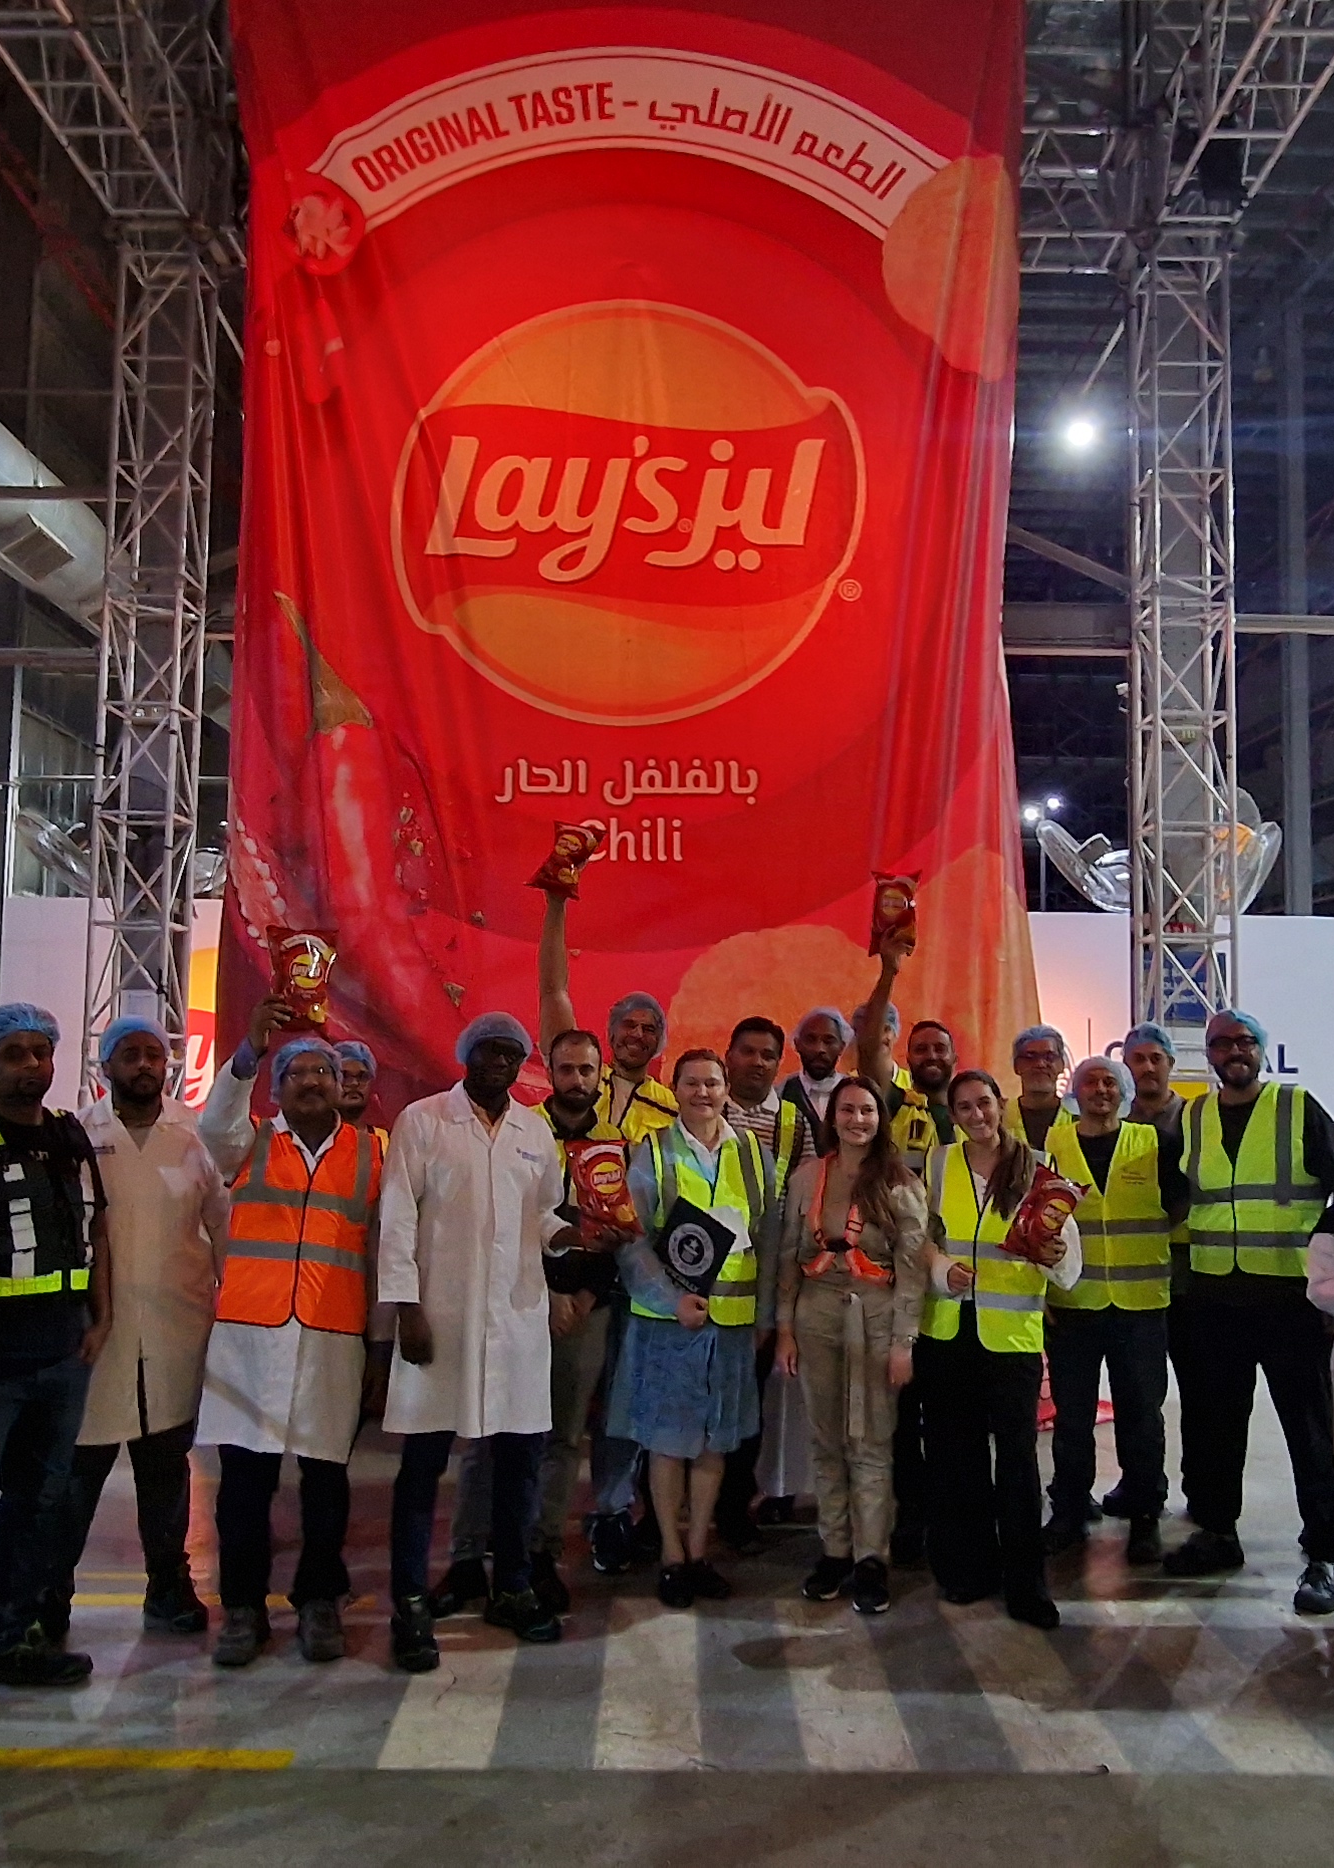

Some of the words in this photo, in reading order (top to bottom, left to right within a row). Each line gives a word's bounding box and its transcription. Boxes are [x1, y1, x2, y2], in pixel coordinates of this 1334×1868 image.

[351, 102, 510, 192] ORIGINAL
[508, 82, 616, 132] TASTE
[792, 130, 907, 200] الطعم
[424, 435, 689, 581] Lay's
[643, 438, 827, 571] ليز
[494, 758, 587, 804] الحار
[603, 758, 759, 805] بالفلفل
